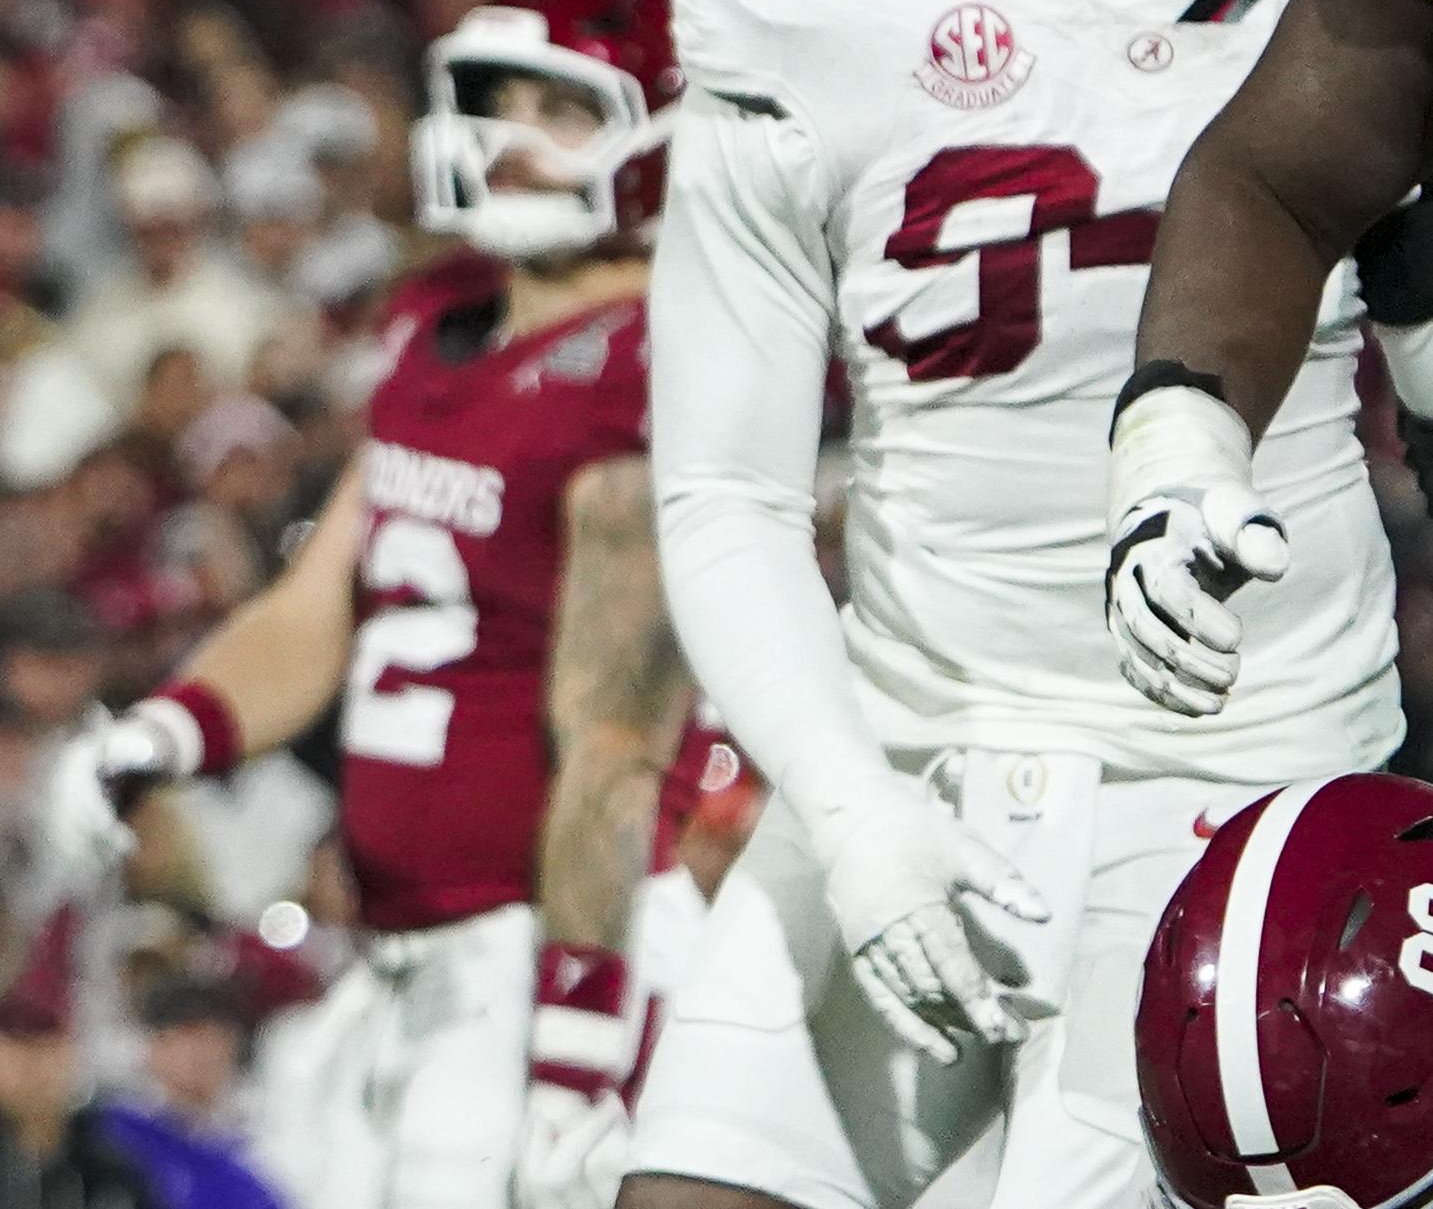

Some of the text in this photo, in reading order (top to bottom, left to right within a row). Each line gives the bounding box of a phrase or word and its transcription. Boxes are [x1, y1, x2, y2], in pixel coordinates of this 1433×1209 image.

[932, 5, 1012, 80] SEC
[863, 144, 1167, 381] 9
[339, 519, 480, 768] 2
